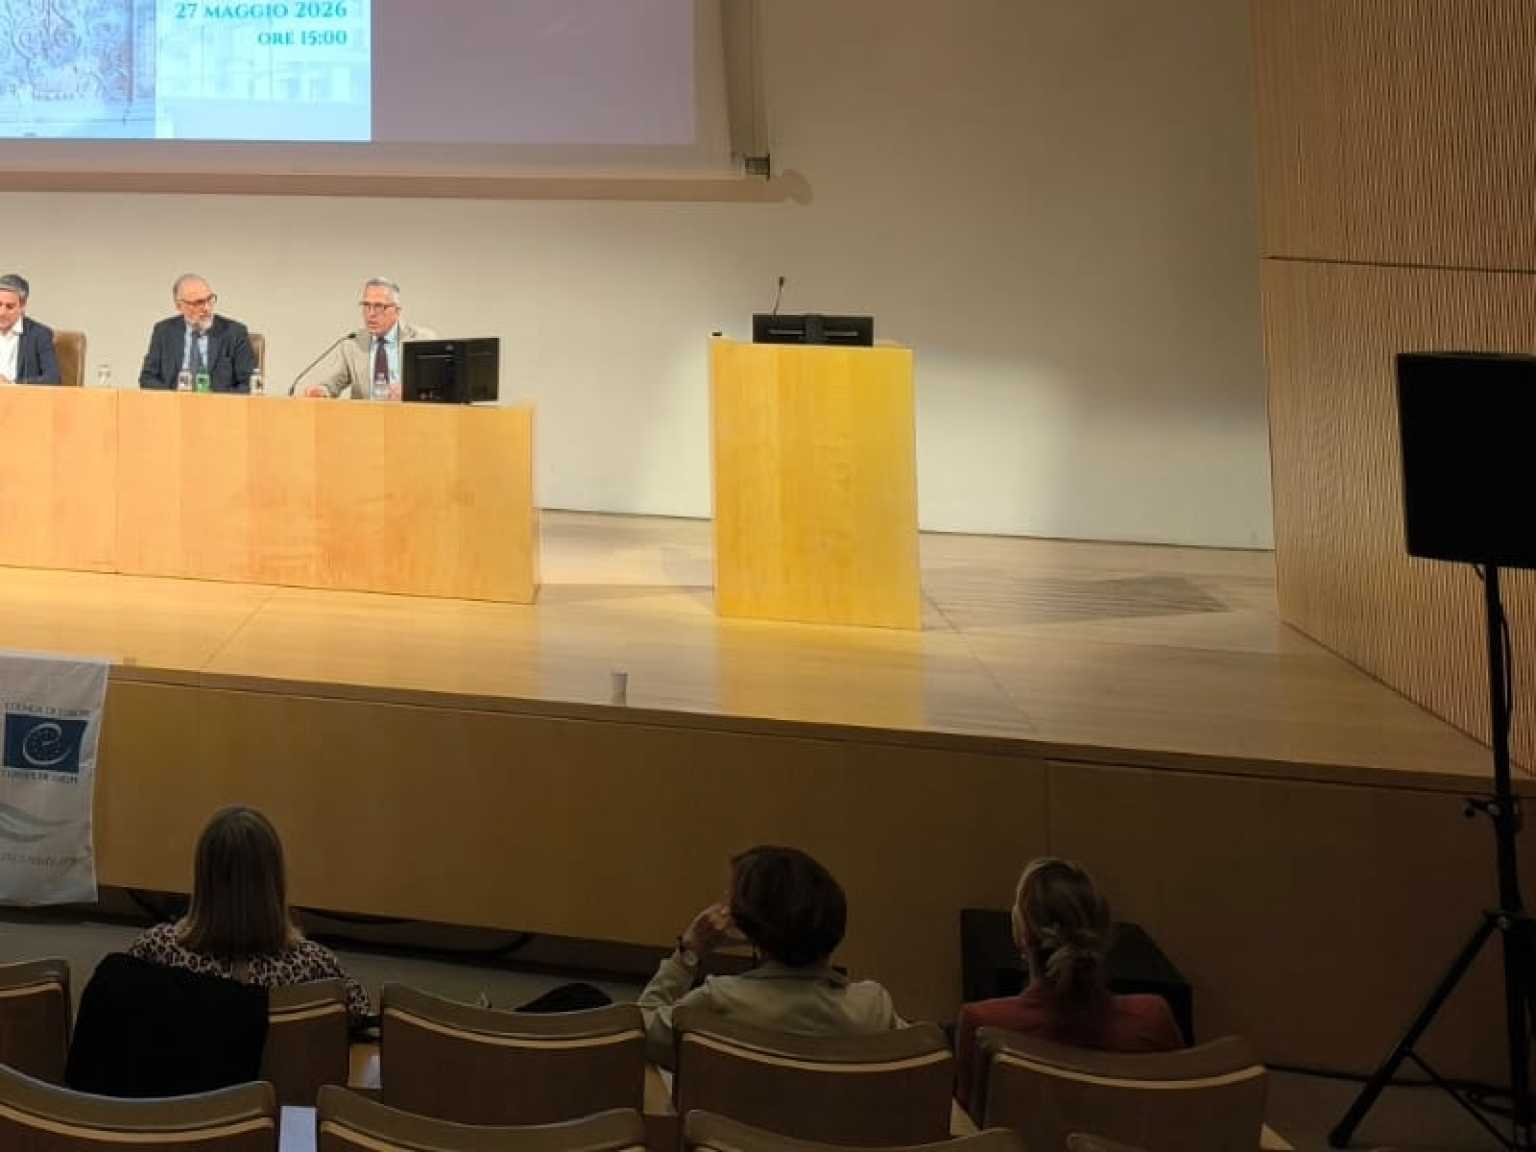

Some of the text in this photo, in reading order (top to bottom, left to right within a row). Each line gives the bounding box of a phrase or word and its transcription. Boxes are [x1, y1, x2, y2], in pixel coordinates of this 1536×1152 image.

[175, 1, 347, 19] 27 MAGGIO 2026
[258, 30, 347, 46] ORE 15:00
